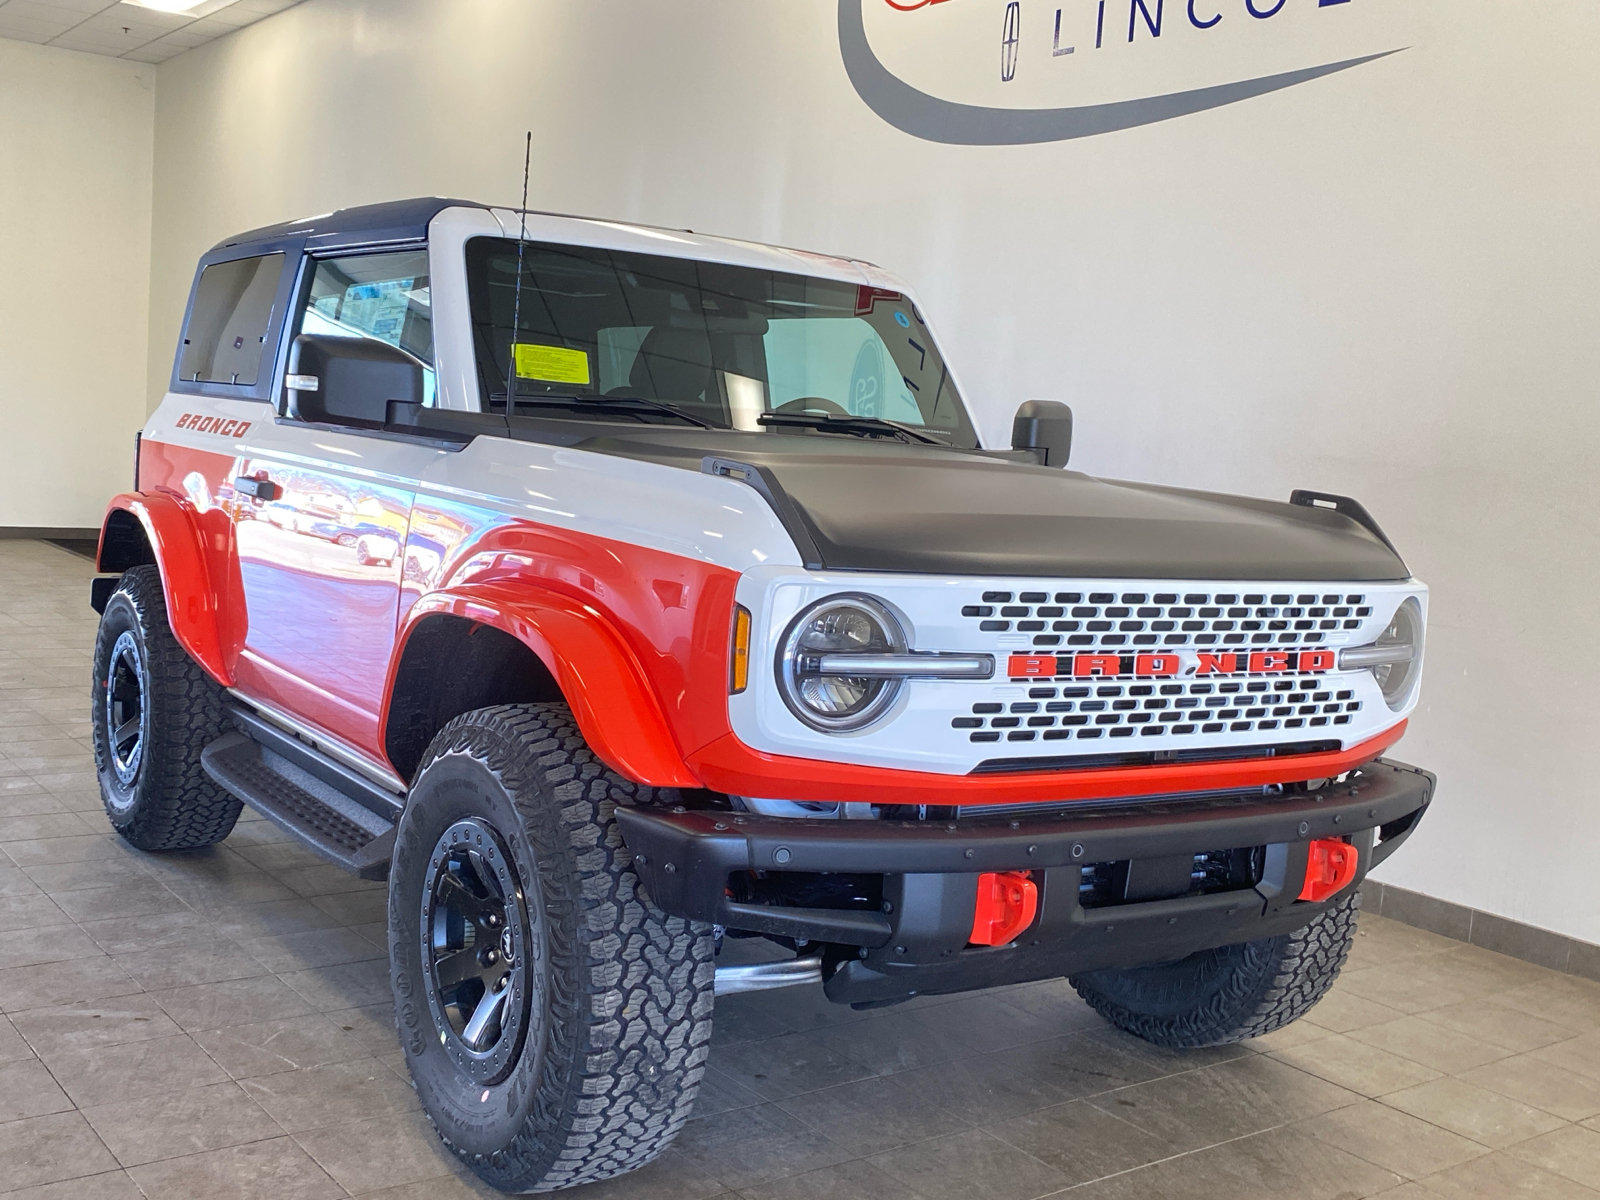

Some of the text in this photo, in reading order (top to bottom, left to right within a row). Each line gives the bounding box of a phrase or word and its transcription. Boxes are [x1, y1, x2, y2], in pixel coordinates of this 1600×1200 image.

[1053, 0, 1351, 57] LINC
[175, 413, 252, 438] BRONCO
[1007, 650, 1335, 678] BRONCO
